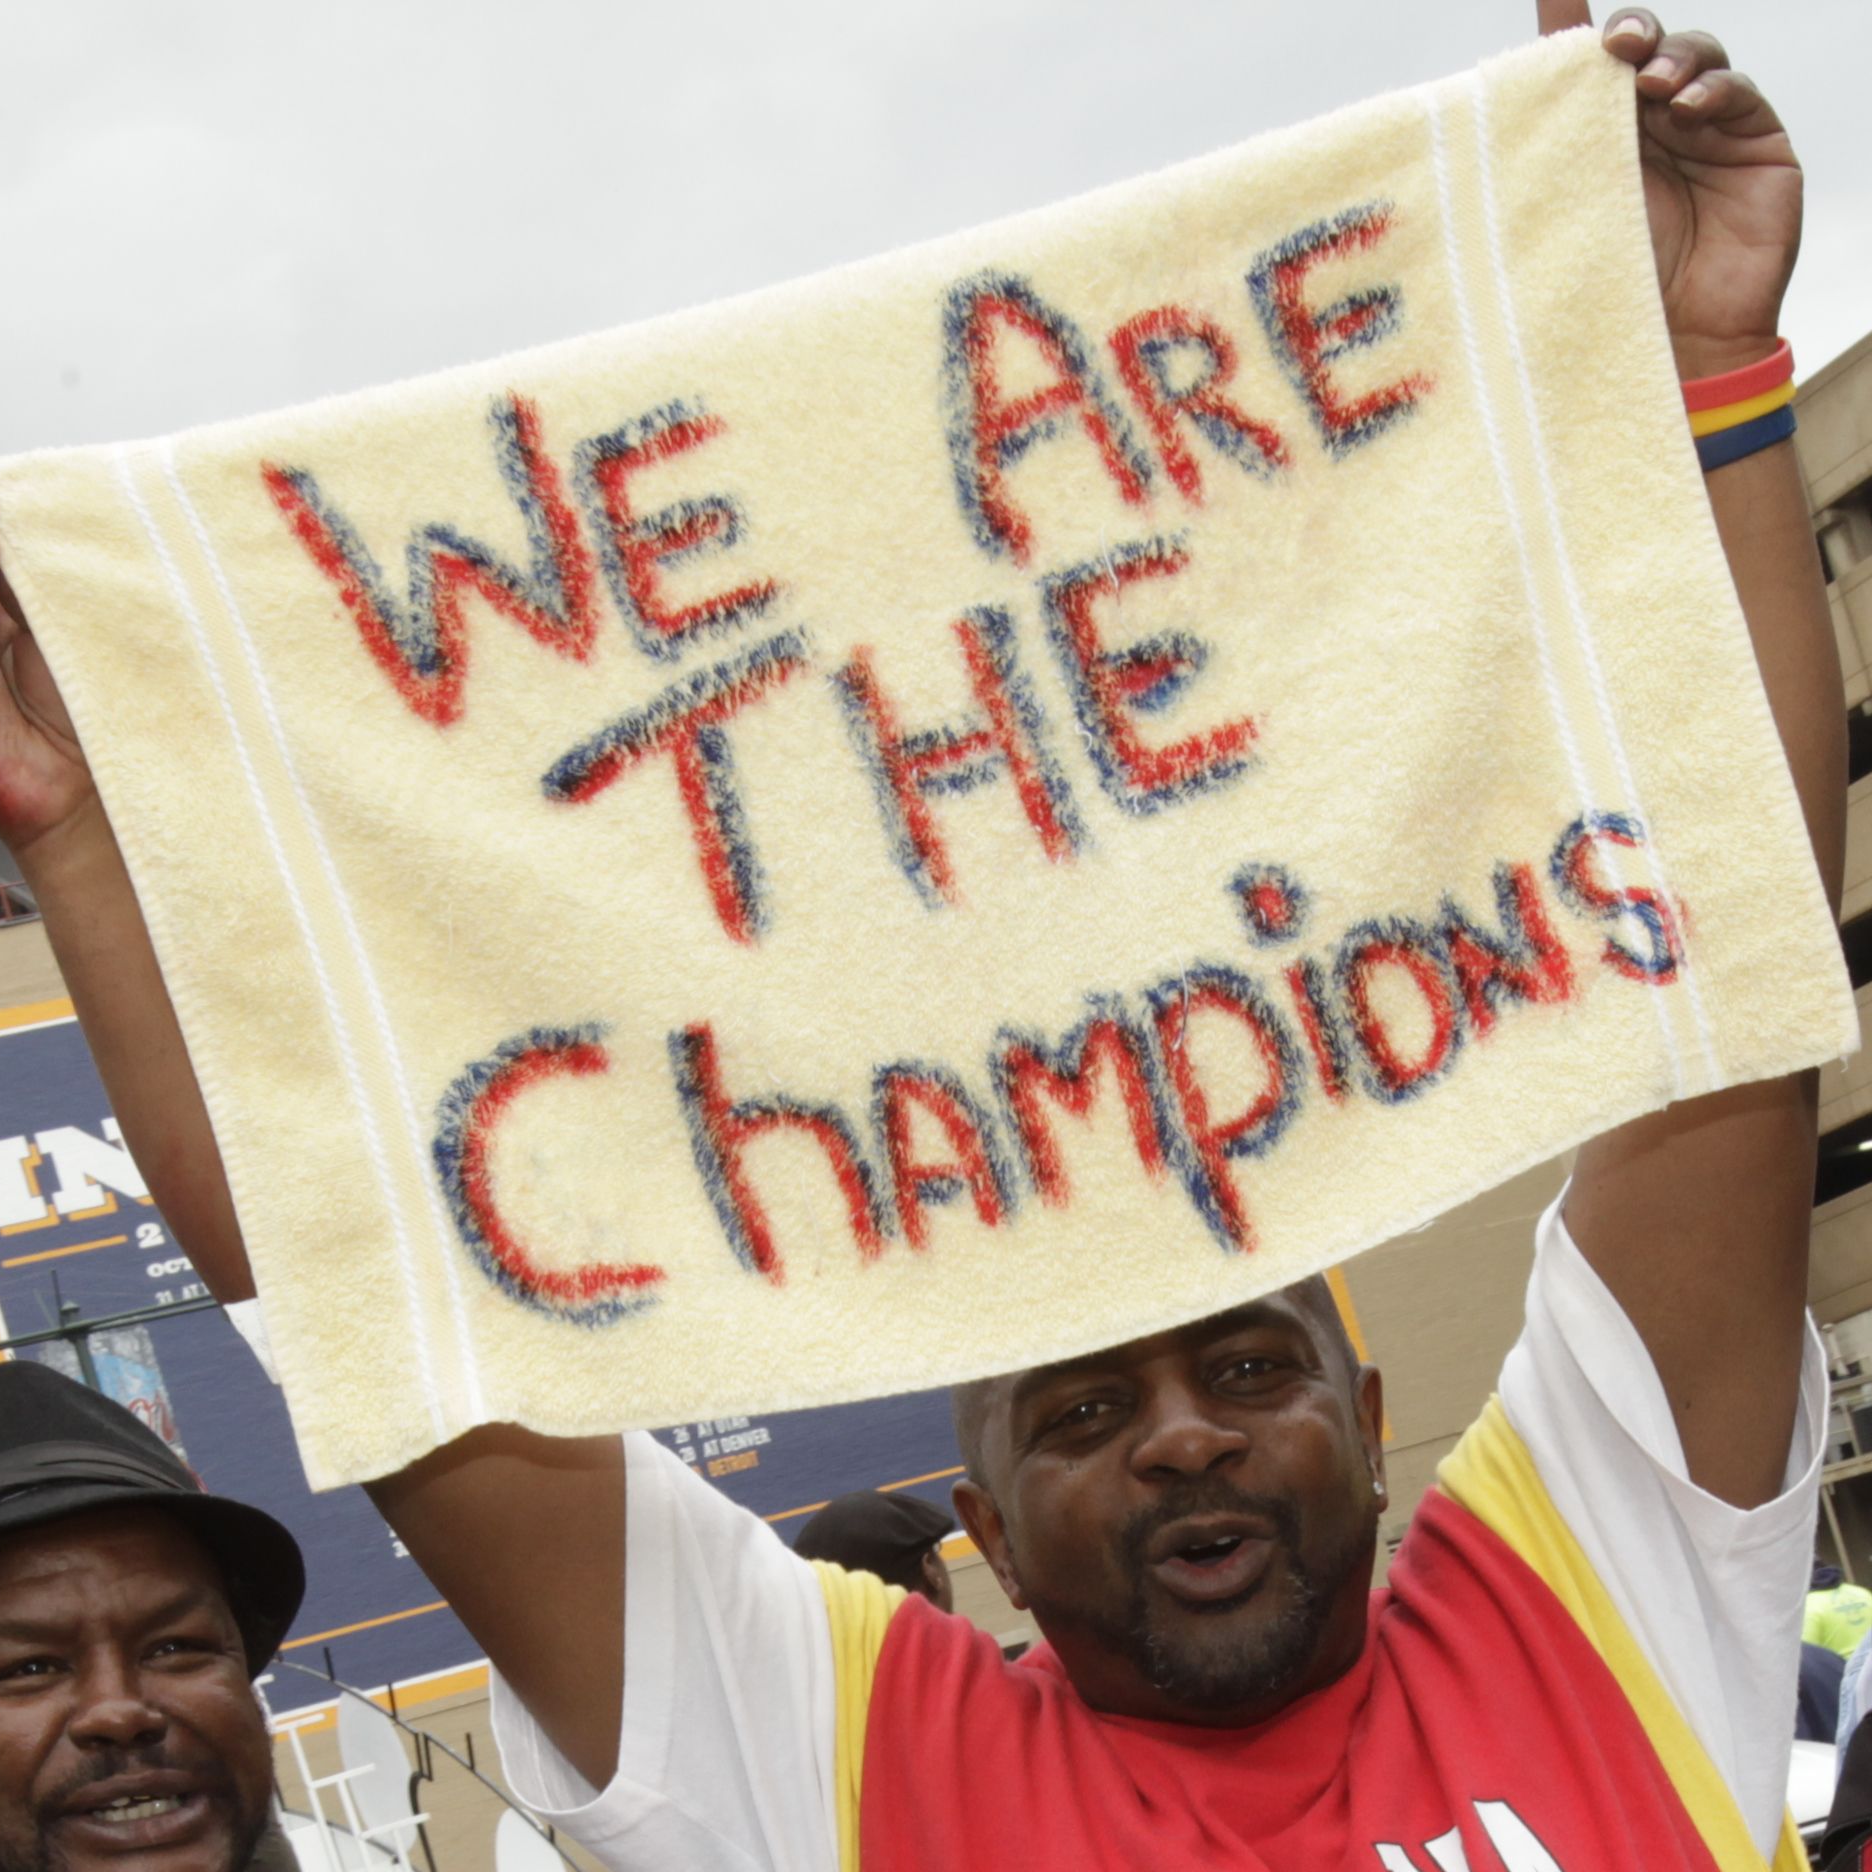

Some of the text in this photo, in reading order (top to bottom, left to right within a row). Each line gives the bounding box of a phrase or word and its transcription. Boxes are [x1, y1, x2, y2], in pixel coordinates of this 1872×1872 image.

[264, 195, 1440, 731] WE ARE
[540, 531, 1269, 947] THE
